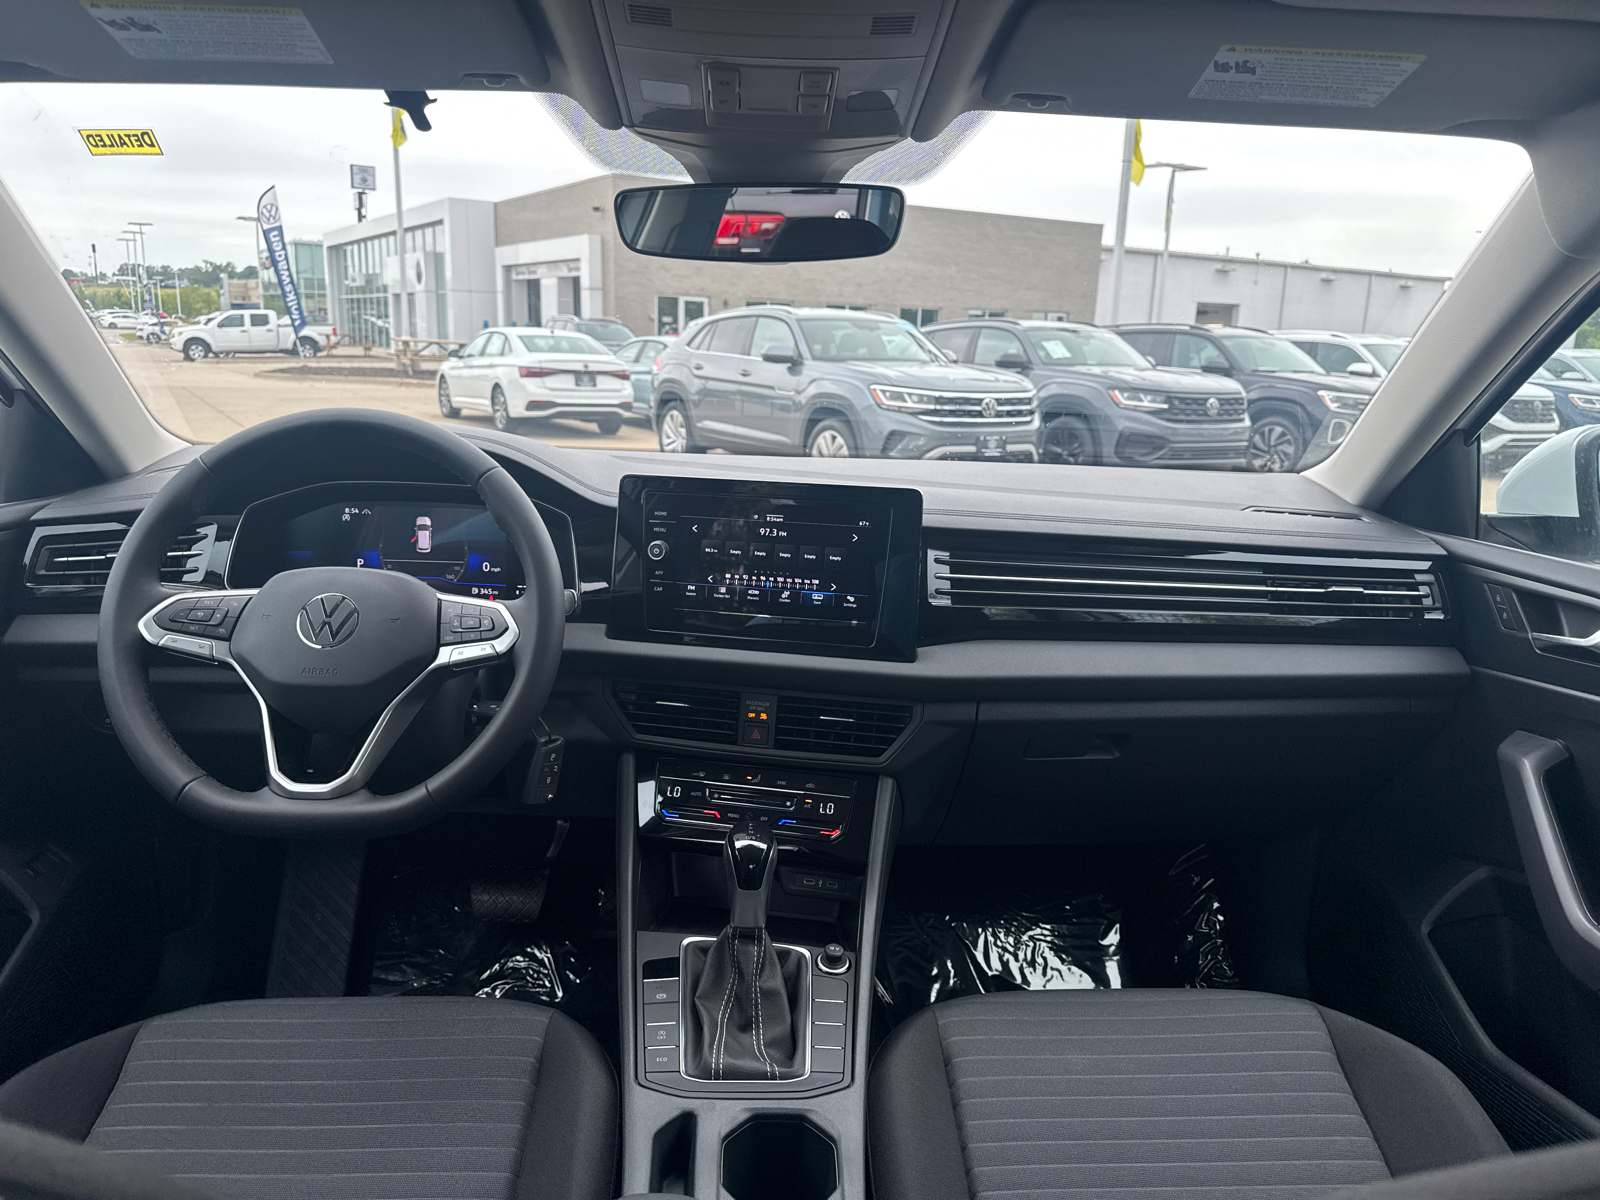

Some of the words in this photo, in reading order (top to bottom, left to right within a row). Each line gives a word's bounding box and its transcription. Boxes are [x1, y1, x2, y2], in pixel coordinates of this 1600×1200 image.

[269, 230, 302, 327] Volkswagen
[759, 528, 778, 537] 97.3
[357, 558, 365, 569] P
[482, 561, 490, 572] 0
[479, 587, 493, 595] 345
[296, 592, 360, 650] VW
[301, 667, 340, 677] AIRBAG
[666, 786, 682, 798] LO
[819, 802, 835, 815] LO
